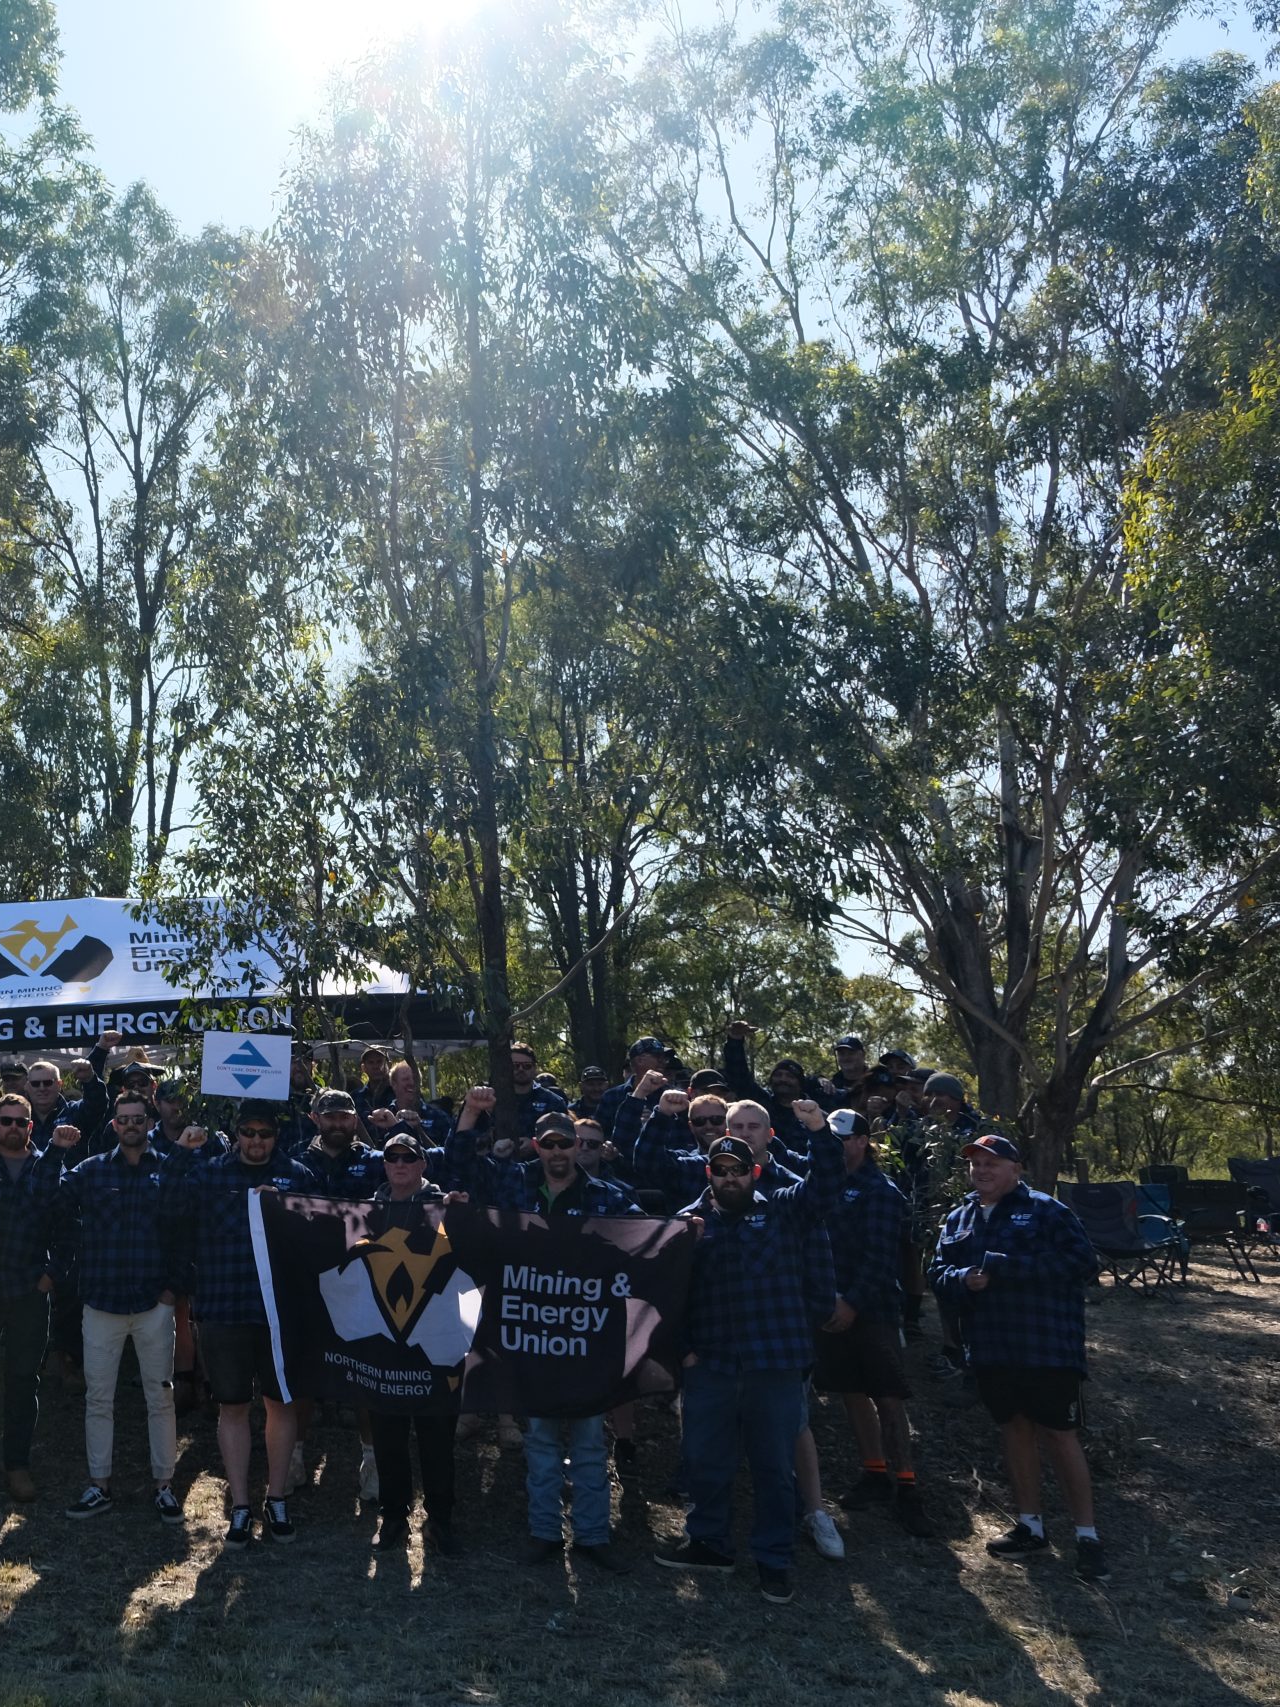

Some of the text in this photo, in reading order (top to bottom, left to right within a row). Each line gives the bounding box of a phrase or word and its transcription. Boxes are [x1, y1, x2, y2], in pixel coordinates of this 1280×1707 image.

[10, 990, 64, 1000] ENERGY
[17, 984, 63, 994] MINING
[23, 1016, 47, 1039] &
[56, 1010, 180, 1038] ENERGY
[720, 1140, 733, 1152] NY
[502, 1264, 633, 1302] Mining &
[500, 1294, 610, 1333] Energy
[500, 1324, 588, 1357] Union
[324, 1351, 433, 1381] NORTHERN MINING
[345, 1370, 433, 1396] & NSW ENERGY
